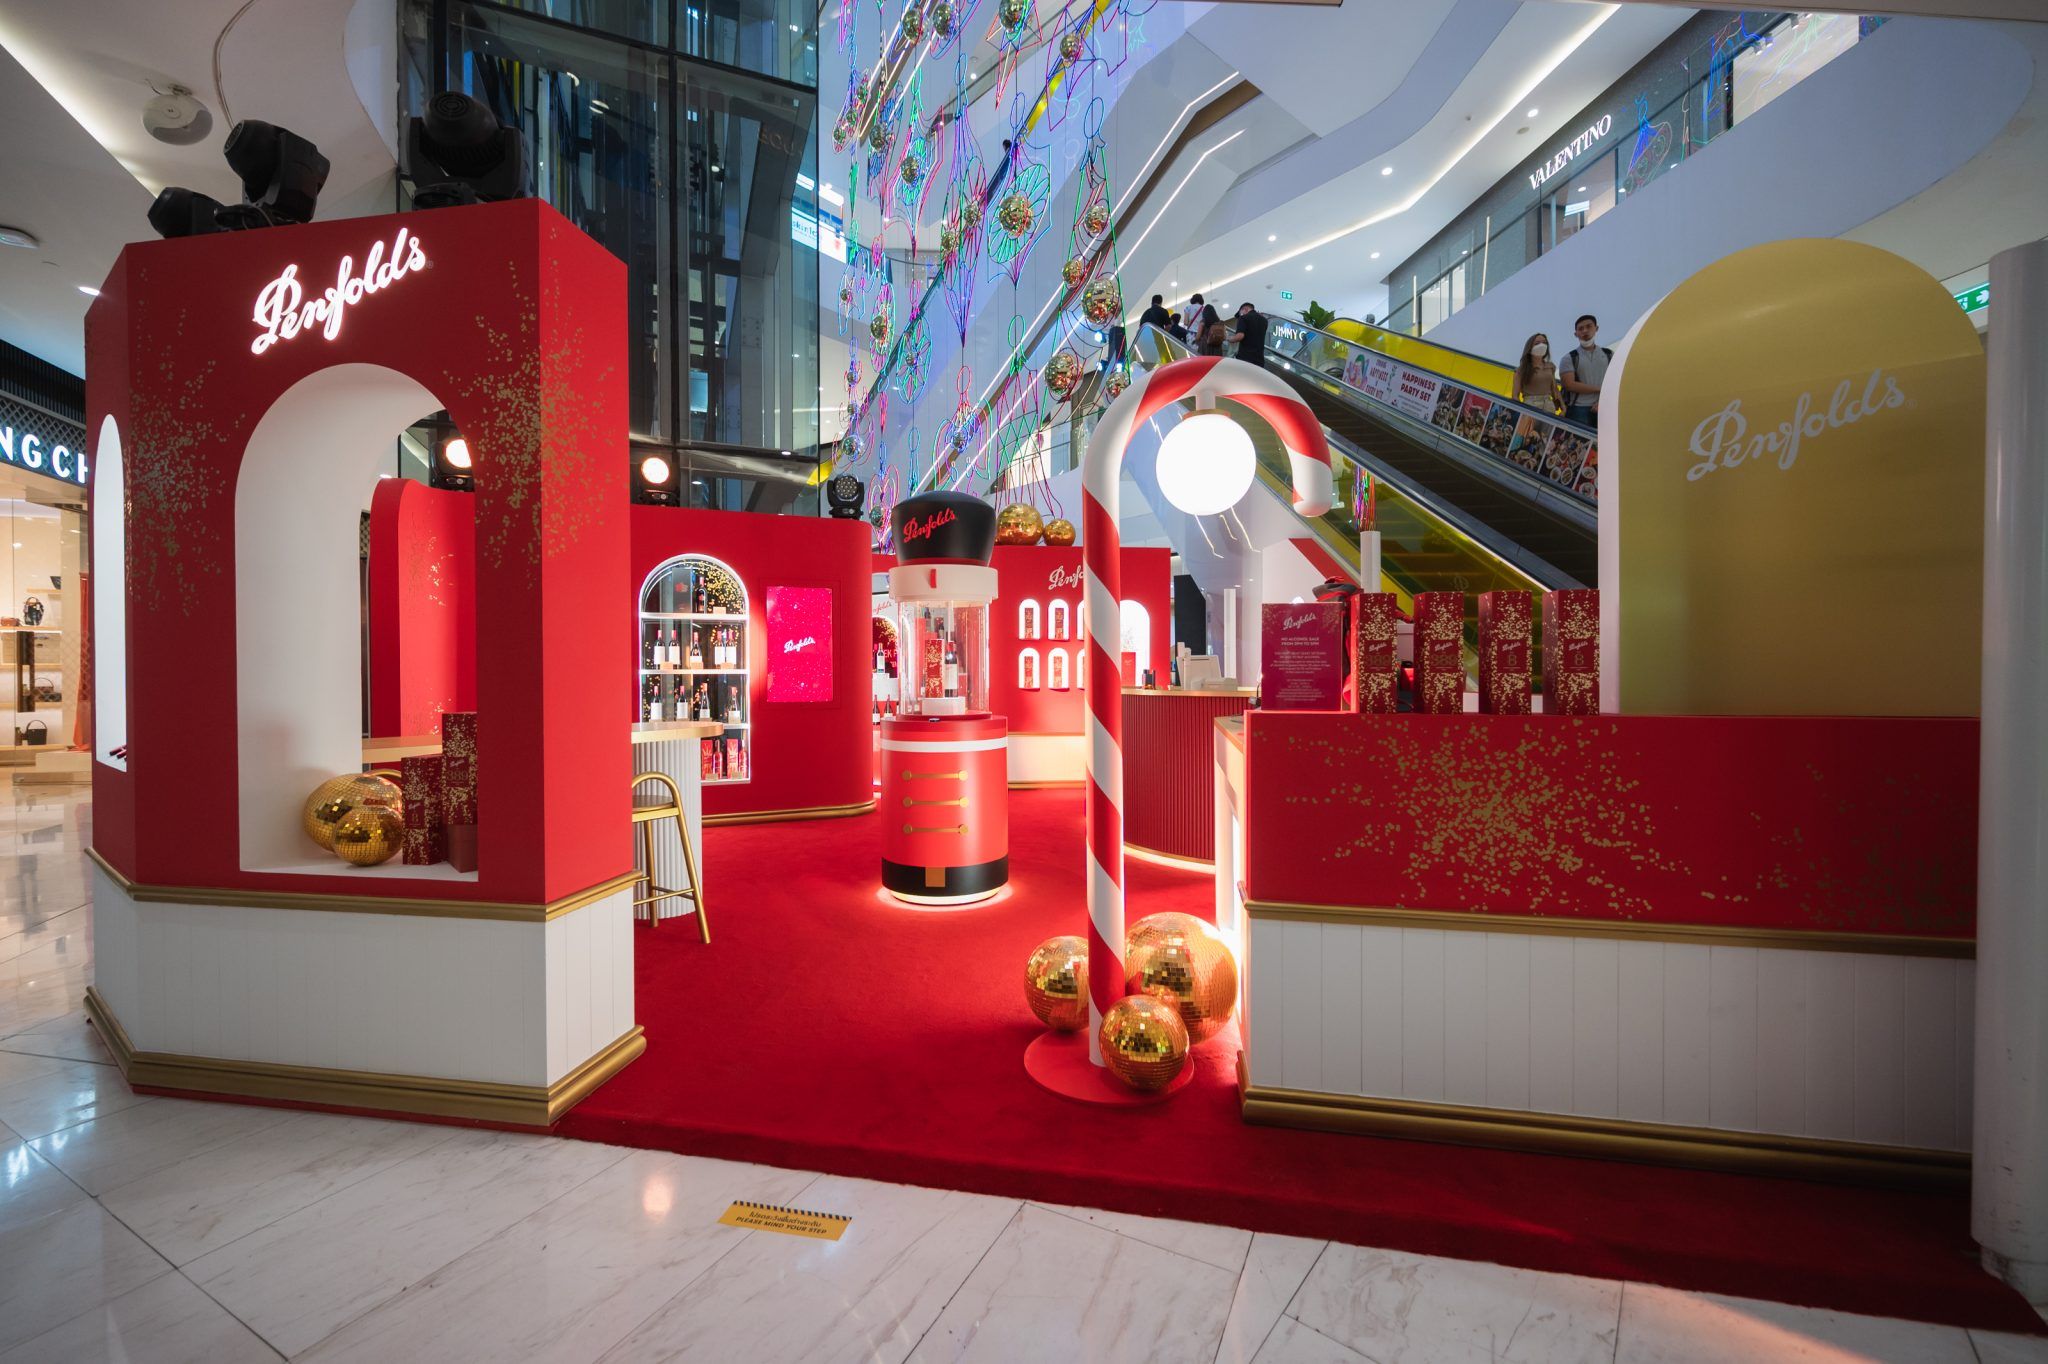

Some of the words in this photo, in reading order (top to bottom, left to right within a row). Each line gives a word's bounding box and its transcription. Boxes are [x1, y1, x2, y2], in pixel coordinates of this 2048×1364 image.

[1529, 114, 1612, 190] VALENTINO
[251, 227, 426, 355] Penfolds
[1273, 325, 1297, 340] JIMMY
[1402, 371, 1437, 391] HAPPINESS
[1400, 383, 1419, 398] PARTY
[1420, 391, 1432, 402] SET
[1686, 367, 1905, 481] Penfolds
[903, 507, 956, 543] Penfolds
[1283, 613, 1316, 630] Penfolds
[783, 636, 816, 653] Penfolds
[735, 1216, 764, 1226] PLEASE
[764, 1220, 784, 1228] MIND
[786, 1224, 806, 1232] YOUR
